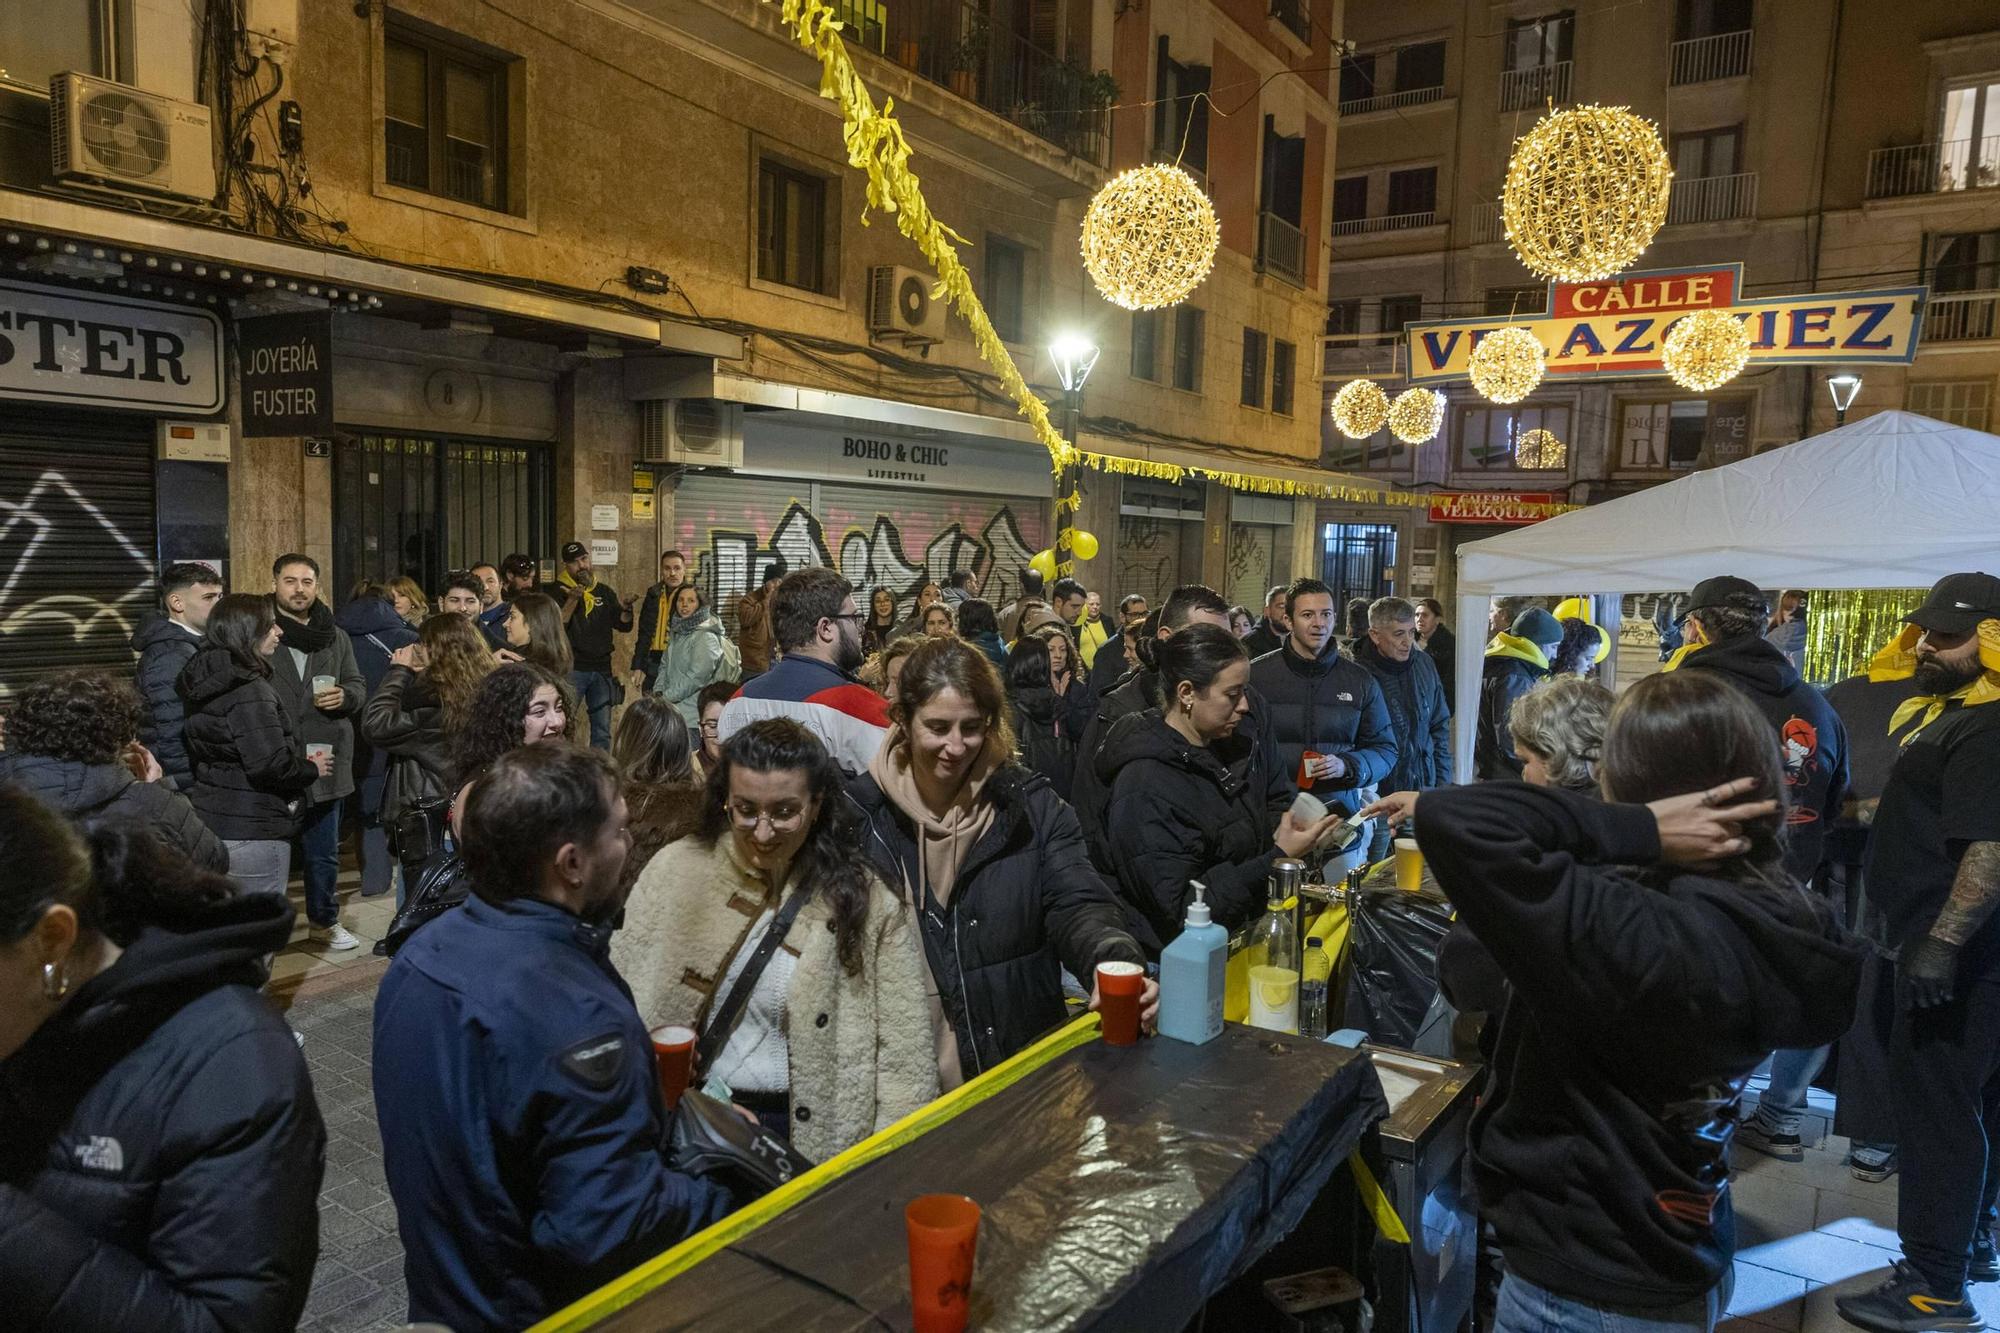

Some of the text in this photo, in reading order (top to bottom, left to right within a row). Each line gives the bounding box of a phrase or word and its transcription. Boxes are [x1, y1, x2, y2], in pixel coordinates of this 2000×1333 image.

[1572, 278, 1713, 312] CALLE
[246, 337, 318, 375] JOYERÍA
[253, 387, 317, 416] FUSTER
[843, 437, 948, 466] BOHO & CHIC
[867, 469, 926, 481] LIFESTYLE
